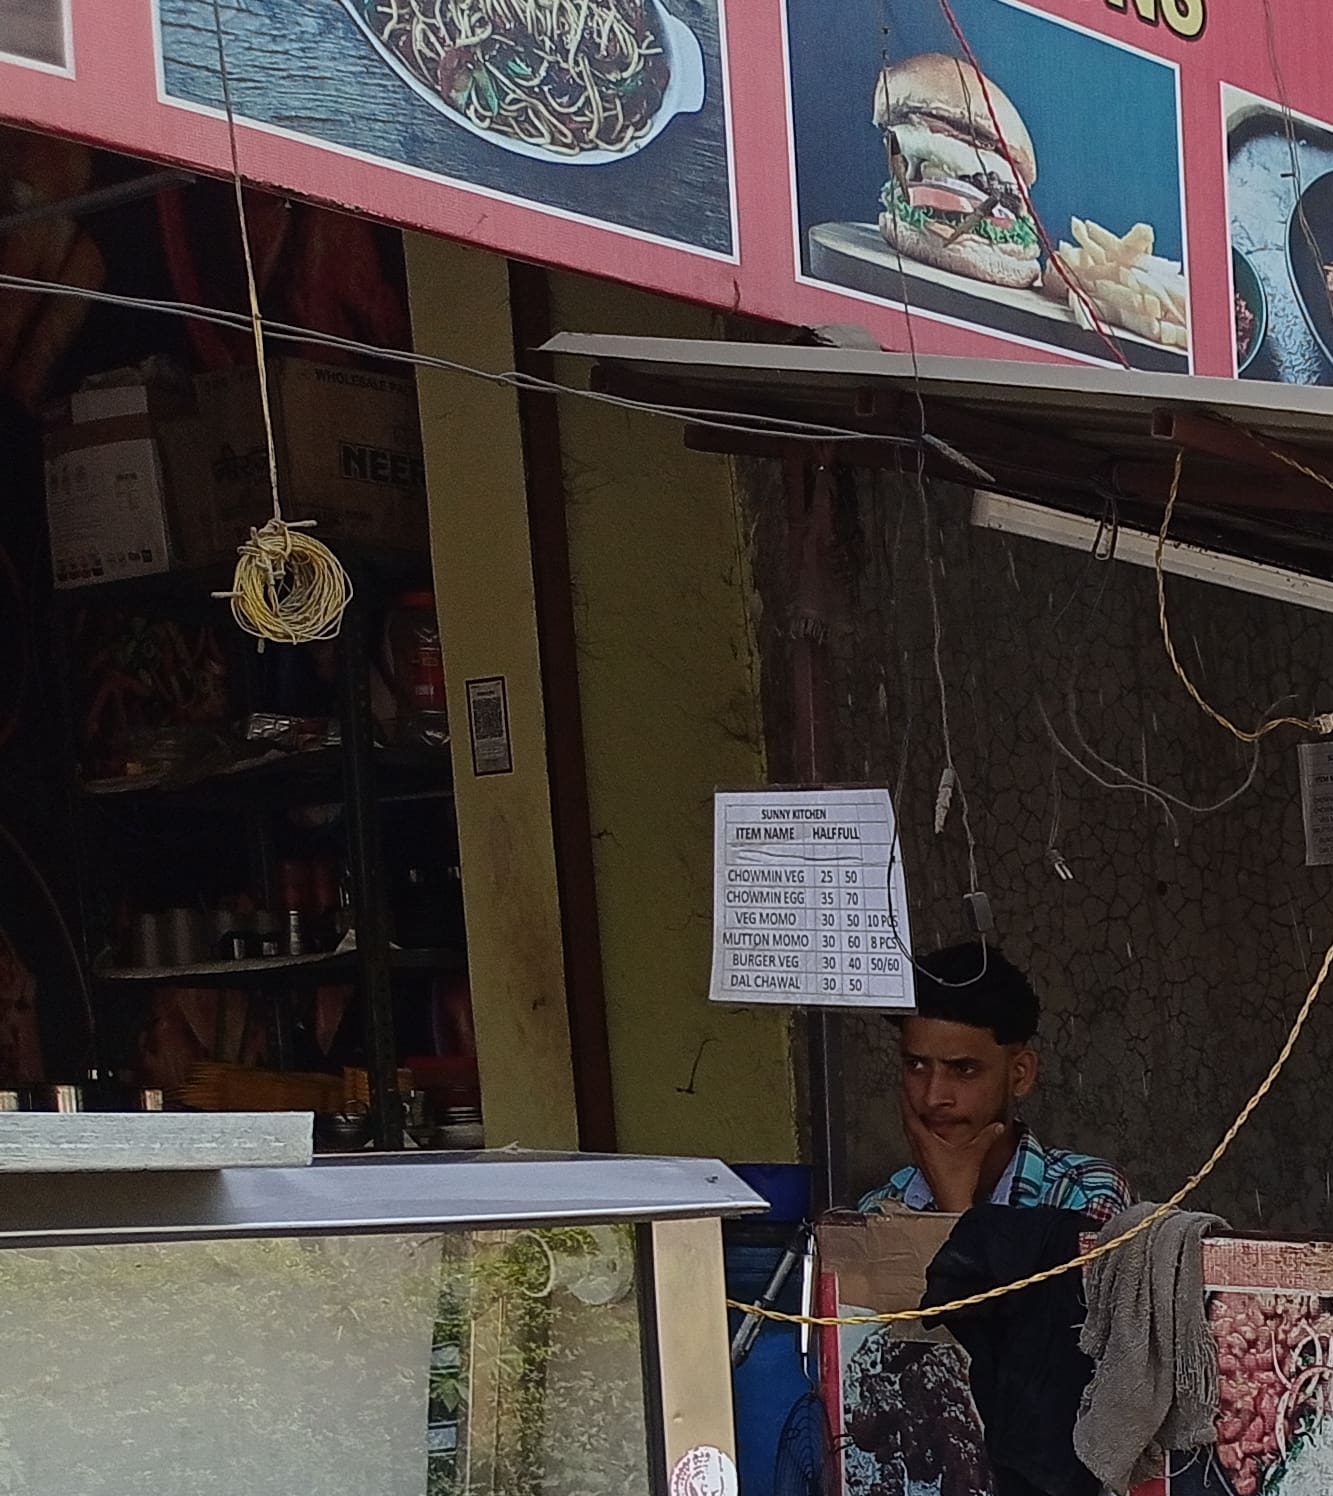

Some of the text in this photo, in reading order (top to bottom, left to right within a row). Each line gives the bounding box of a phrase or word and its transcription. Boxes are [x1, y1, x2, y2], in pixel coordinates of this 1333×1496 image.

[762, 809, 826, 820] SUNNY KITCHEN
[736, 827, 860, 840] ITEM NAME HALF FULL
[728, 866, 857, 884] CHOWMIN VEG 25 50
[727, 887, 858, 905] CHOWMIN EGG 35 70
[736, 911, 756, 925] VEG
[759, 912, 796, 925] MOMO
[822, 914, 834, 926] 30
[847, 914, 859, 927] 50
[868, 915, 879, 927] 10
[723, 933, 897, 949] MUTTON MOMO 30 60 8 PCS
[732, 951, 899, 972] BURGER VEG 30 40 50/60
[730, 974, 862, 991] DAL CHAWAL 30 50
